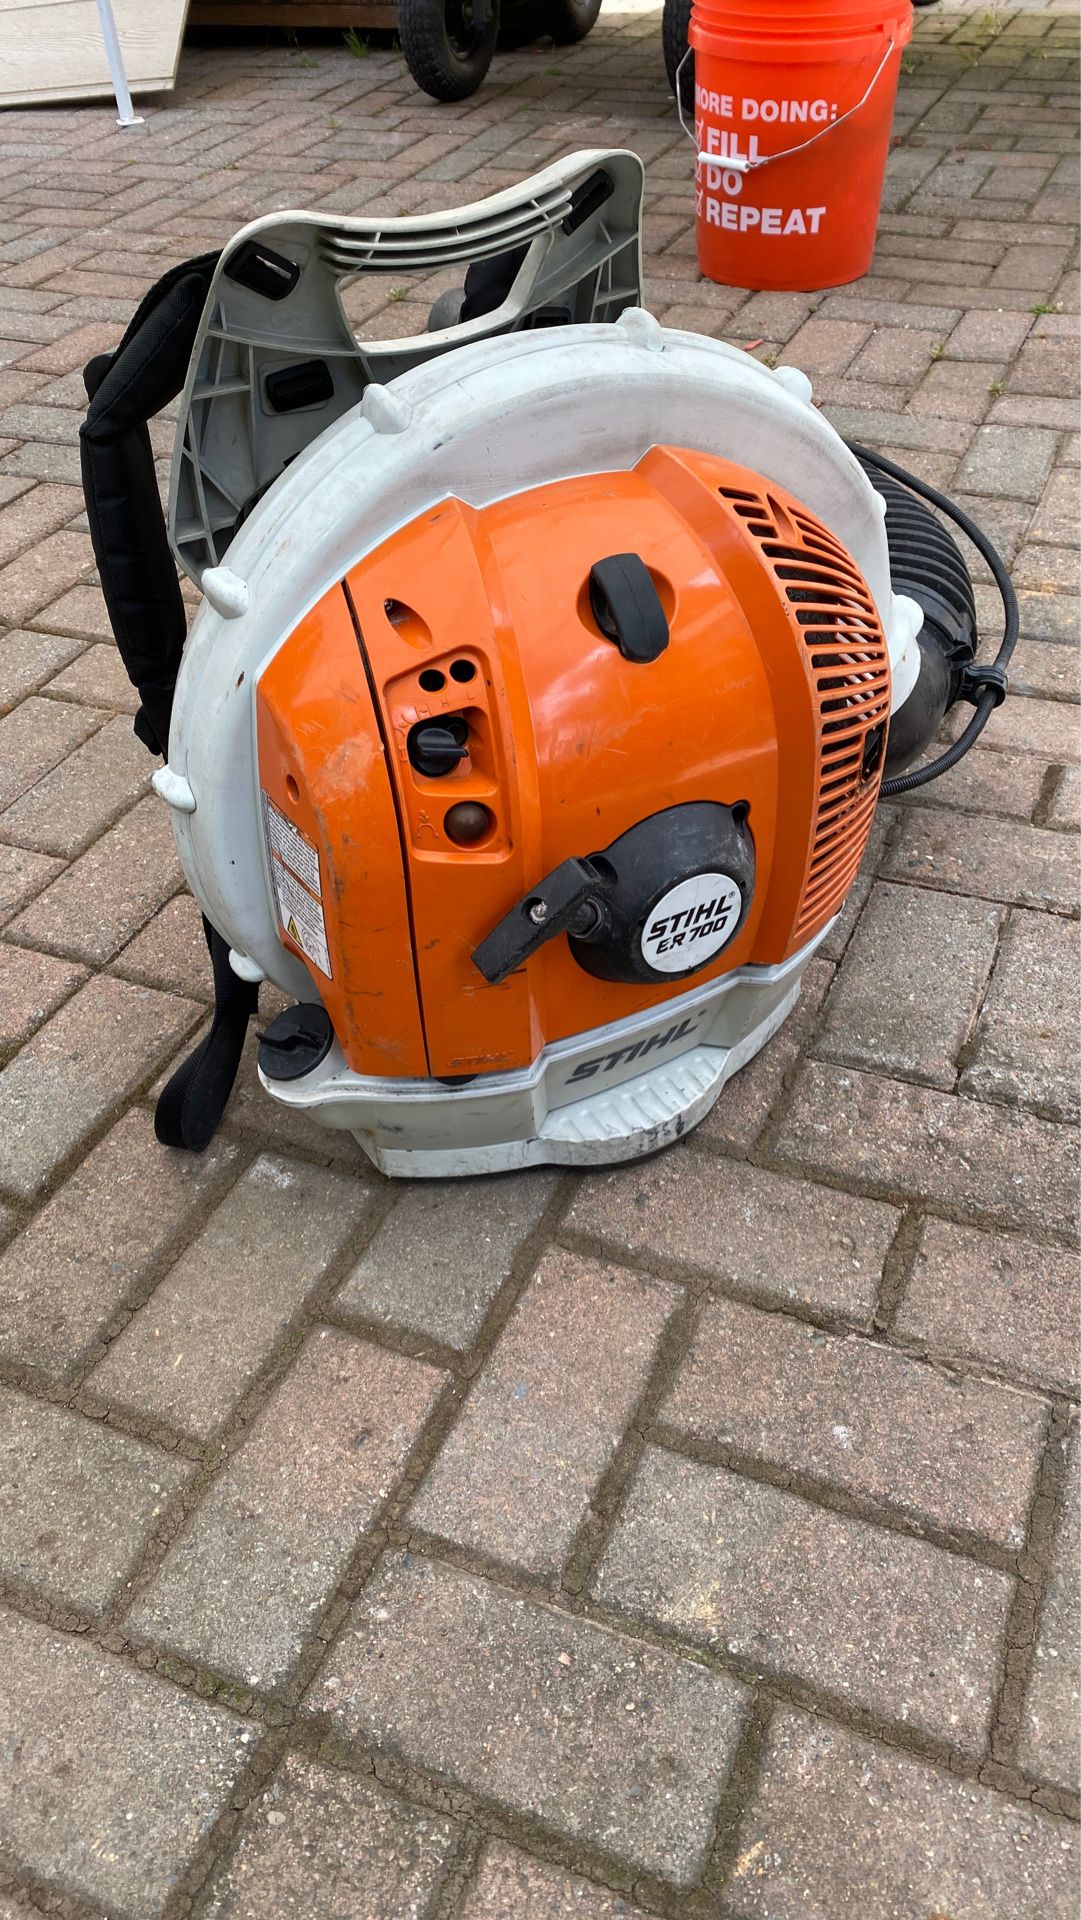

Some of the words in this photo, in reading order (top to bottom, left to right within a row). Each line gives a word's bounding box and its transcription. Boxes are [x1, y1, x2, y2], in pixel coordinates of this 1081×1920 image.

[741, 97, 839, 123] DOING:
[706, 126, 769, 164] FILL
[706, 167, 743, 196] DO
[705, 196, 827, 235] REPEAT
[688, 915, 728, 943] 700
